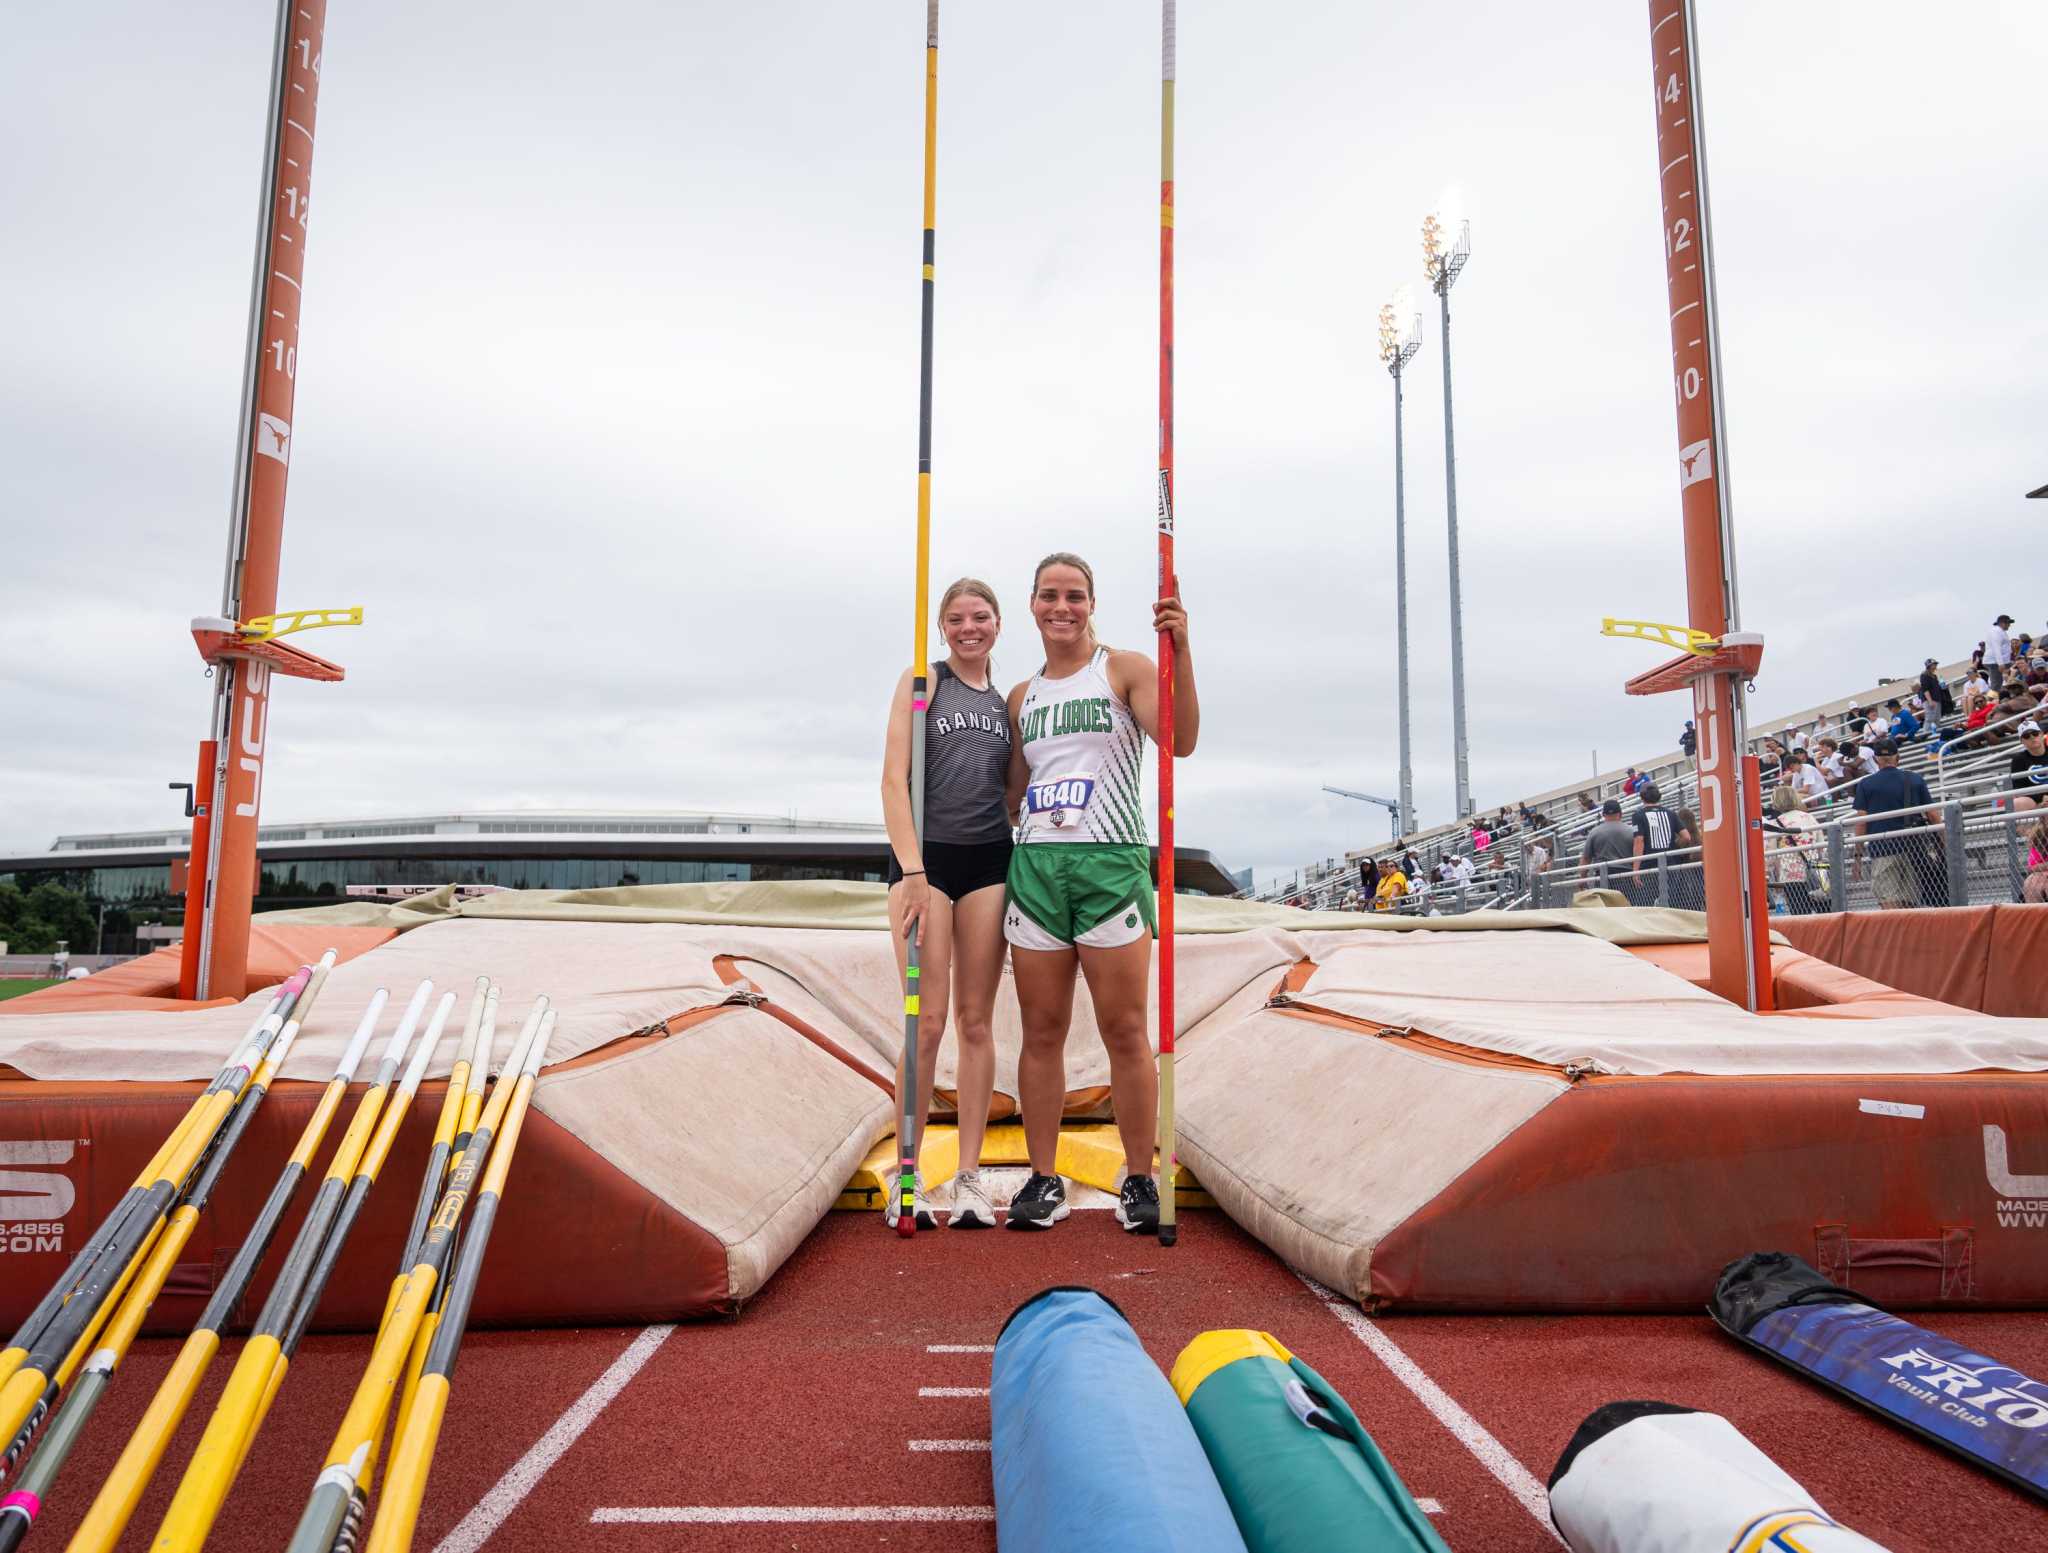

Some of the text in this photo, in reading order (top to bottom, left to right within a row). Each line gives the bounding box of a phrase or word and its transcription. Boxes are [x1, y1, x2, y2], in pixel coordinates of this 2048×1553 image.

[286, 186, 307, 230] 12
[1666, 218, 1690, 258] 12
[272, 339, 296, 379] 10
[1676, 367, 1700, 406] 10
[1052, 698, 1112, 736] LOBOES
[1033, 781, 1086, 809] 1840
[1888, 1373, 1988, 1428] Vault Club
